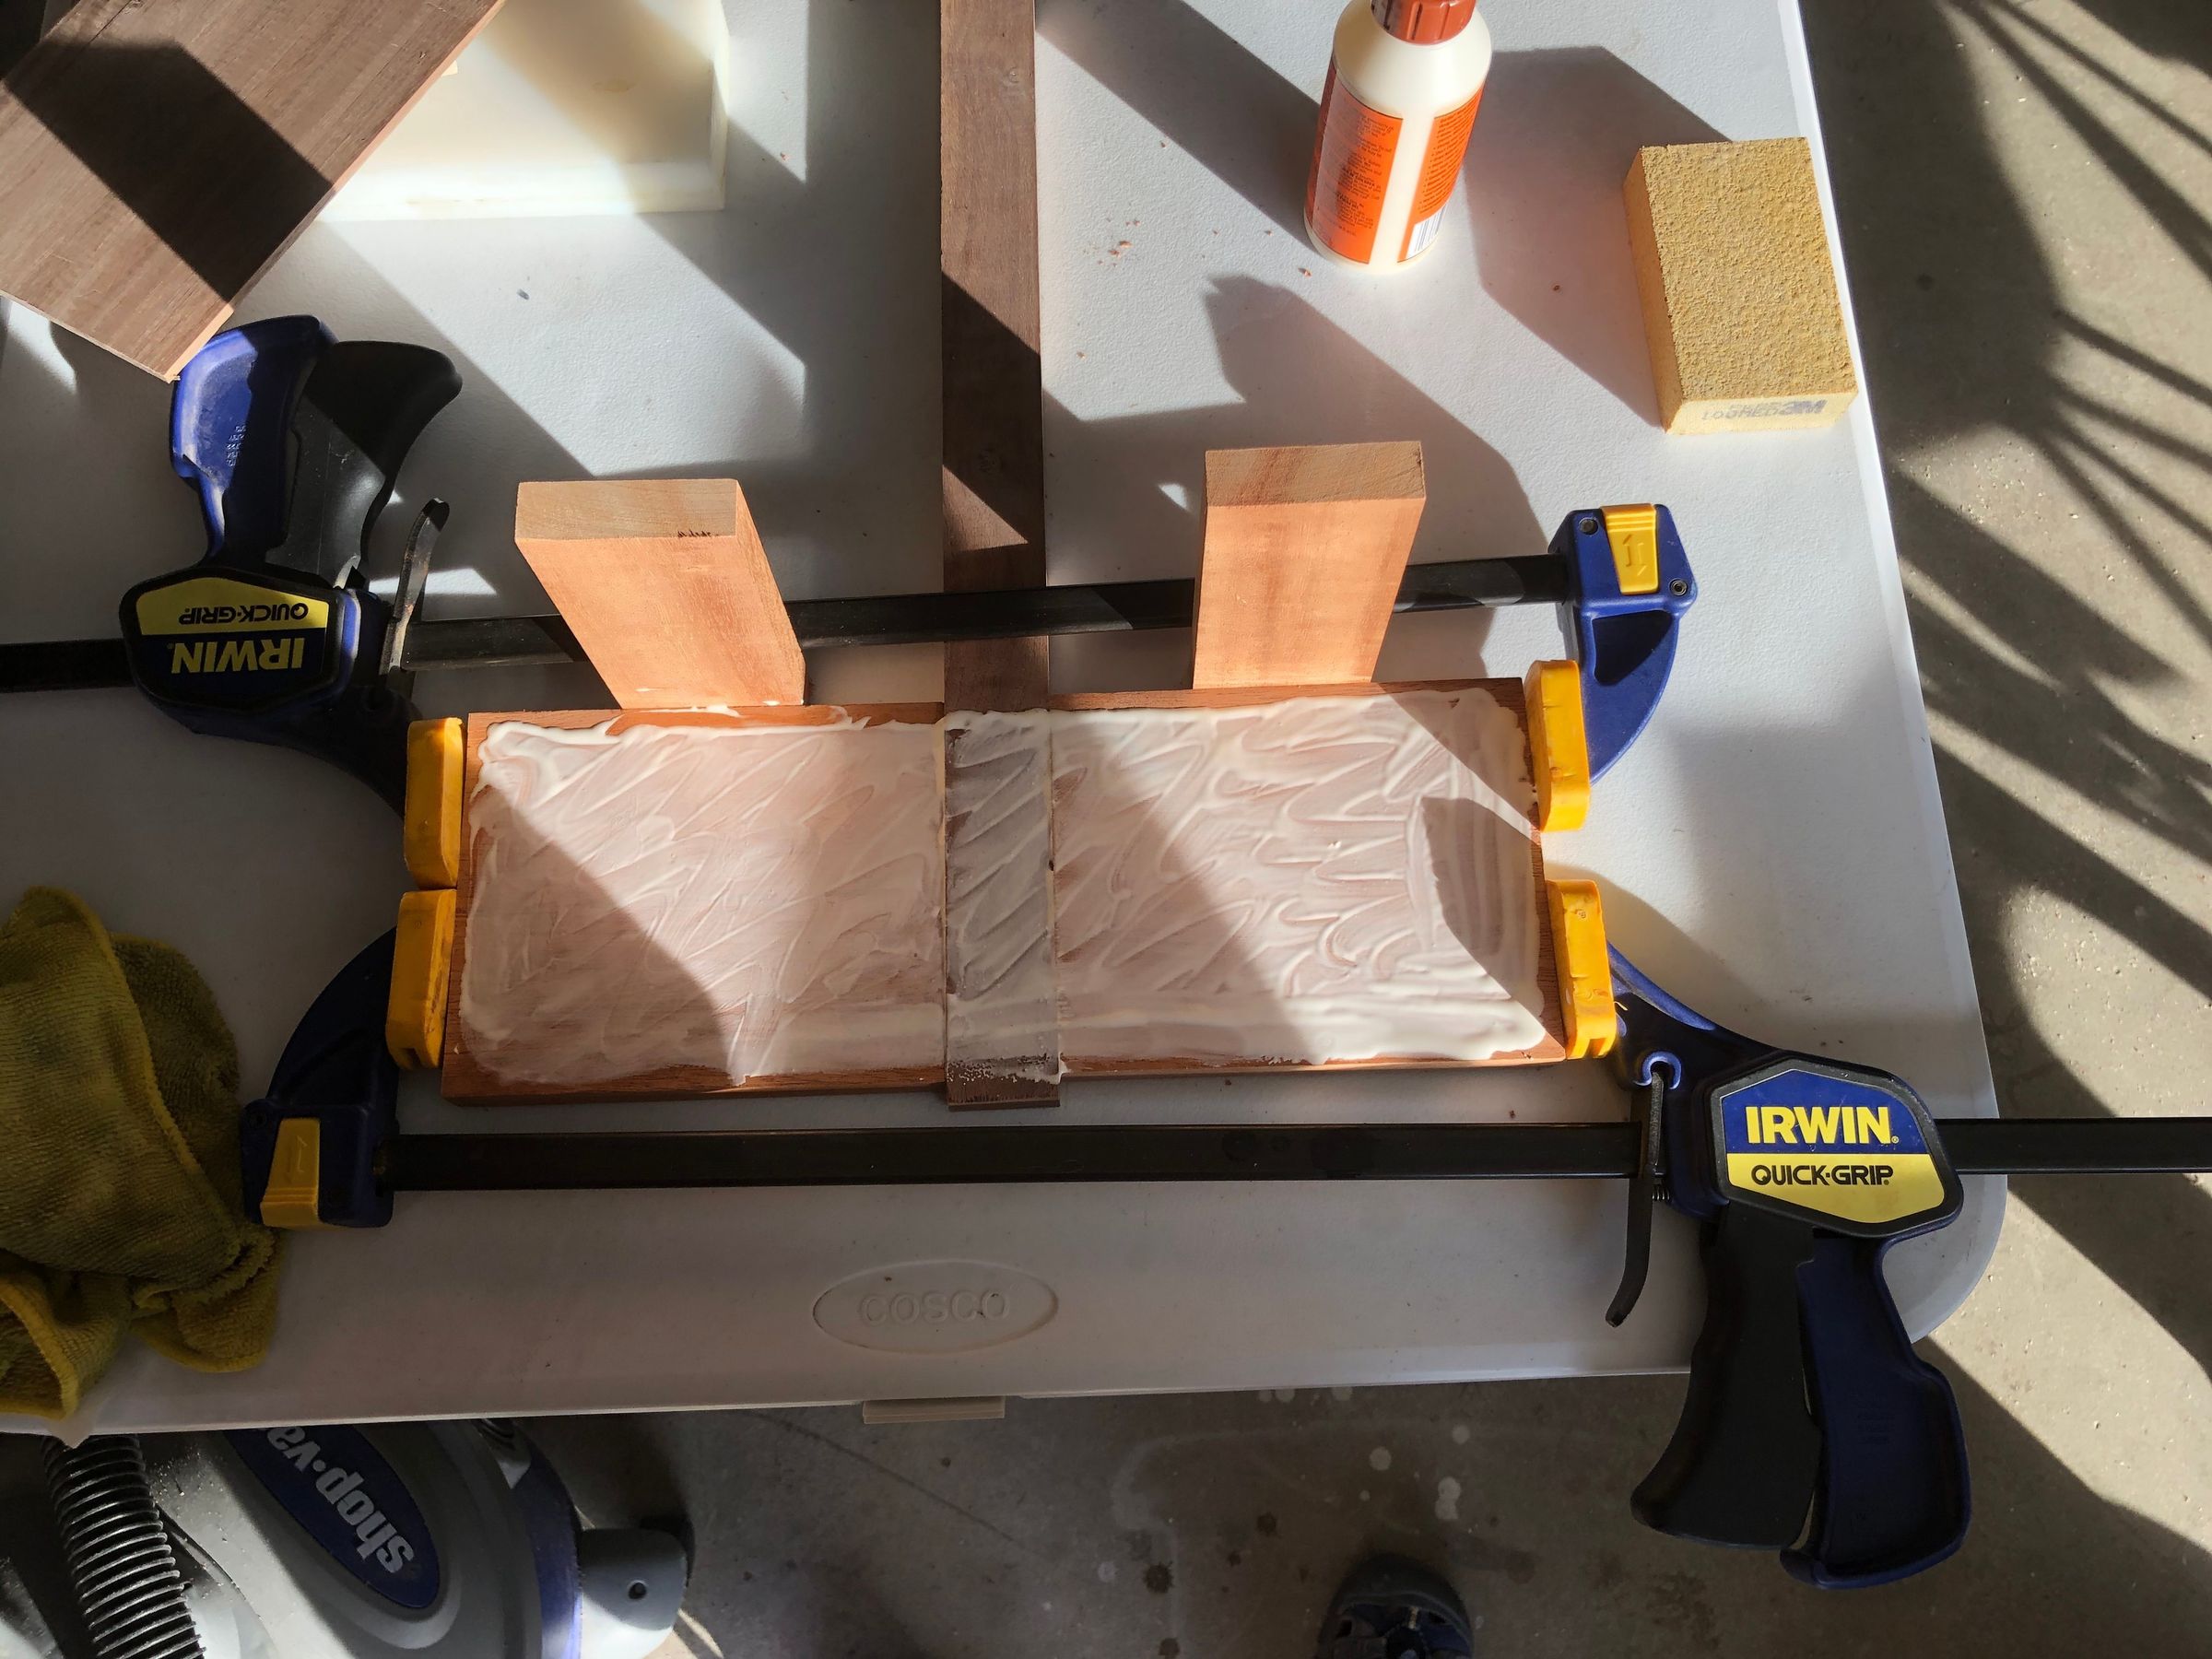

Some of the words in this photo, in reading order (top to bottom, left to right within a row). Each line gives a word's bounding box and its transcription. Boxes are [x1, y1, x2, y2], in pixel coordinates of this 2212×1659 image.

[171, 637, 307, 675] IRWIN
[1745, 1106, 1892, 1145] IRWIN
[860, 1289, 1010, 1327] COSCO
